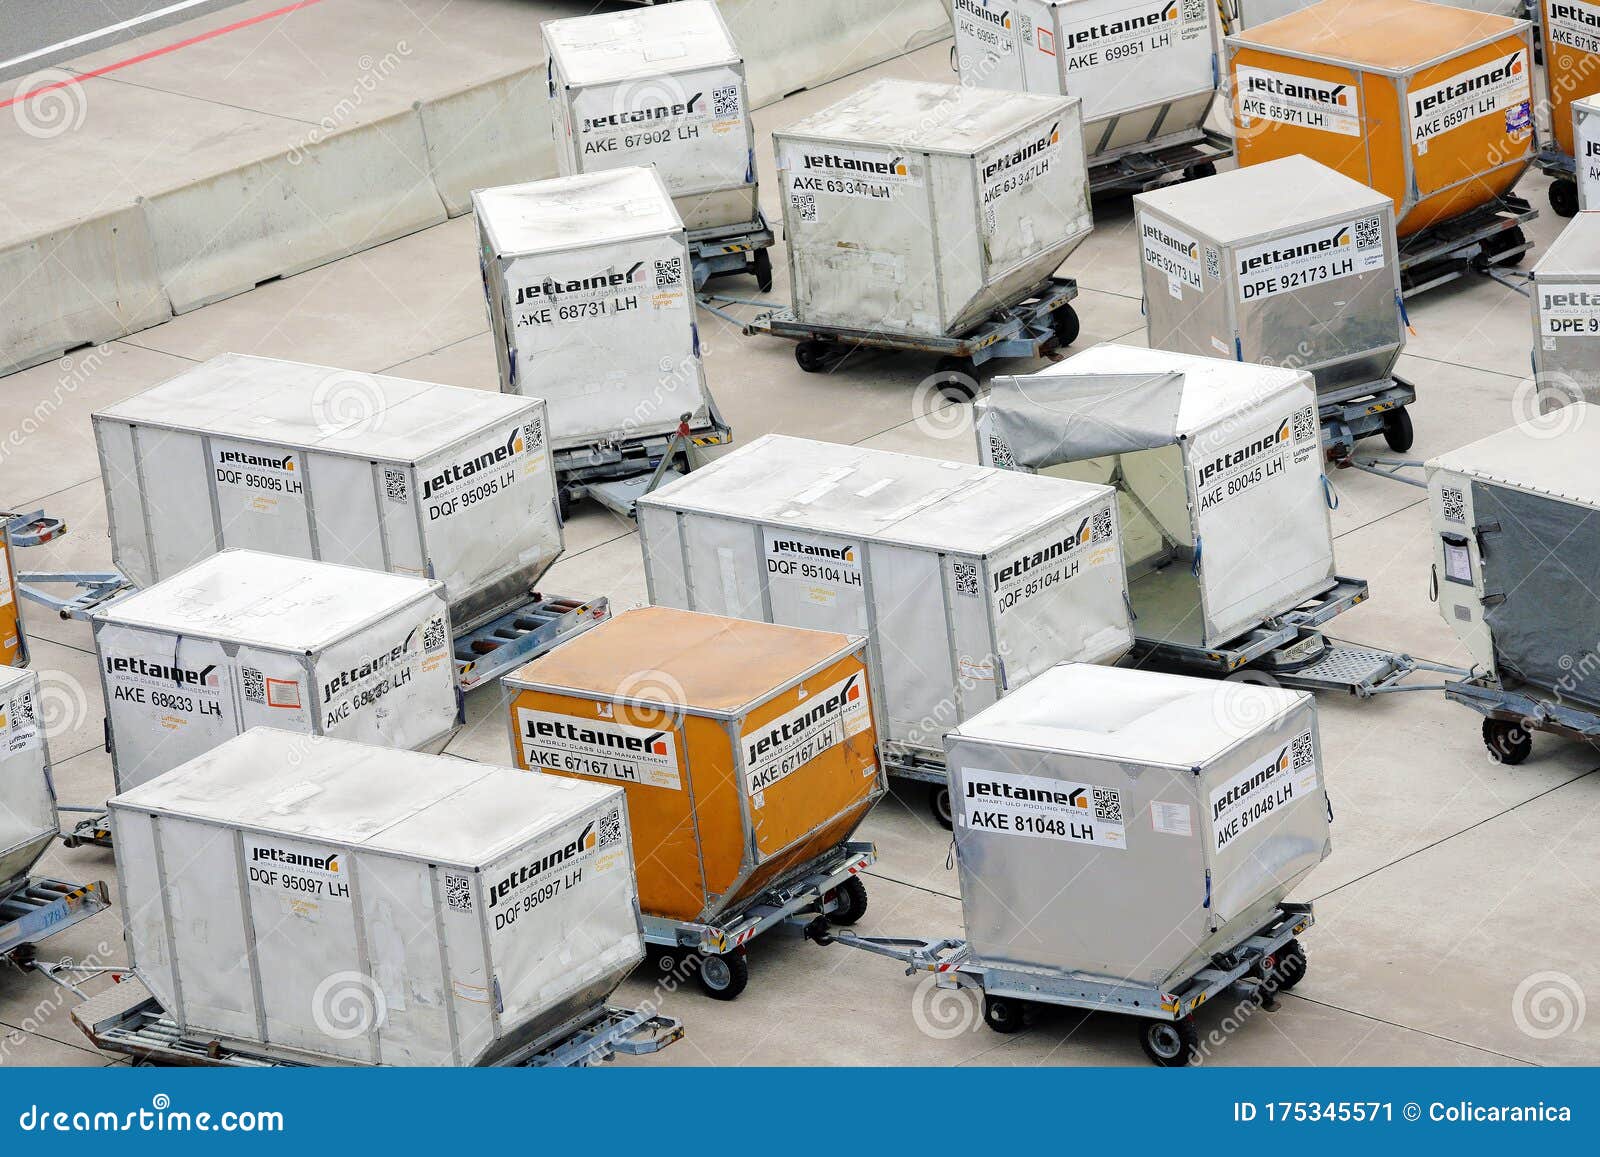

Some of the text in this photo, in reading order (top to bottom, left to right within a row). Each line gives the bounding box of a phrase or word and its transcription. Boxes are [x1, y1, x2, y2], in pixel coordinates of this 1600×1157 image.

[955, 0, 1009, 27] jettainer
[1067, 0, 1176, 49] jettainer
[960, 20, 974, 36] AKE
[977, 28, 998, 45] 69951
[1553, 29, 1600, 52] AKE 6718
[1068, 34, 1168, 70] AKE 69951 LH
[1248, 76, 1346, 104] jettainer
[1414, 52, 1520, 118] jettainer
[583, 92, 702, 133] jettainer
[1243, 99, 1265, 115] AKE
[1270, 106, 1302, 122] 65971
[1307, 112, 1323, 126] LH
[1416, 97, 1495, 139] AKE 65971 LH
[584, 126, 699, 154] AKE 67902 LH
[804, 155, 904, 174] jettainer
[794, 177, 823, 190] AKE
[985, 184, 1000, 205] AKE
[1144, 224, 1196, 256] jettainer
[1240, 226, 1349, 275] jettainer
[515, 261, 645, 304] jettainer
[1146, 248, 1200, 287] DPE 92173 LH
[1244, 258, 1352, 298] DPE 92173 LH
[518, 296, 637, 327] AKE 68731 LH
[1551, 319, 1584, 332] DPE
[220, 452, 293, 470] jettainer
[423, 427, 520, 500] jettainer
[1199, 417, 1288, 487] jettainer
[217, 469, 302, 494] DQF 95095 LH
[430, 469, 515, 521] DQF 95095 LH
[1201, 458, 1282, 511] AKE 80045 LH
[773, 541, 852, 560] jettainer
[994, 516, 1090, 593] jettainer
[768, 559, 861, 586] DQF 95104 LH
[999, 561, 1079, 614] DQF 95104 LH
[107, 657, 216, 686] jettainer
[115, 685, 221, 717] AKE 68233 LH
[327, 701, 349, 728] AKE
[394, 667, 411, 688] LH
[748, 674, 858, 765] jettainer
[526, 720, 666, 754] jettainer
[540, 739, 567, 748] WORLD
[570, 744, 593, 752] CLASS
[615, 752, 668, 765] MANAGEMENT
[530, 750, 560, 767] AKE
[565, 756, 608, 775] 67167
[614, 764, 634, 779] LH
[752, 730, 832, 791] AKE 67167 LH
[760, 748, 782, 764] WORLD
[966, 781, 1086, 807] jettainer
[1214, 746, 1288, 822] jettainer
[971, 811, 1008, 830] AKE
[1015, 815, 1066, 835] 81048
[1070, 822, 1094, 840] LH
[1023, 803, 1058, 812] POOLING
[1061, 808, 1089, 816] PEOPLE
[1218, 783, 1292, 848] AKE 81048 LH
[252, 847, 338, 870] jettainer
[489, 820, 595, 908] jettainer
[250, 867, 349, 897] DQF 95097 LH
[496, 868, 582, 930] DQF 95097 LH
